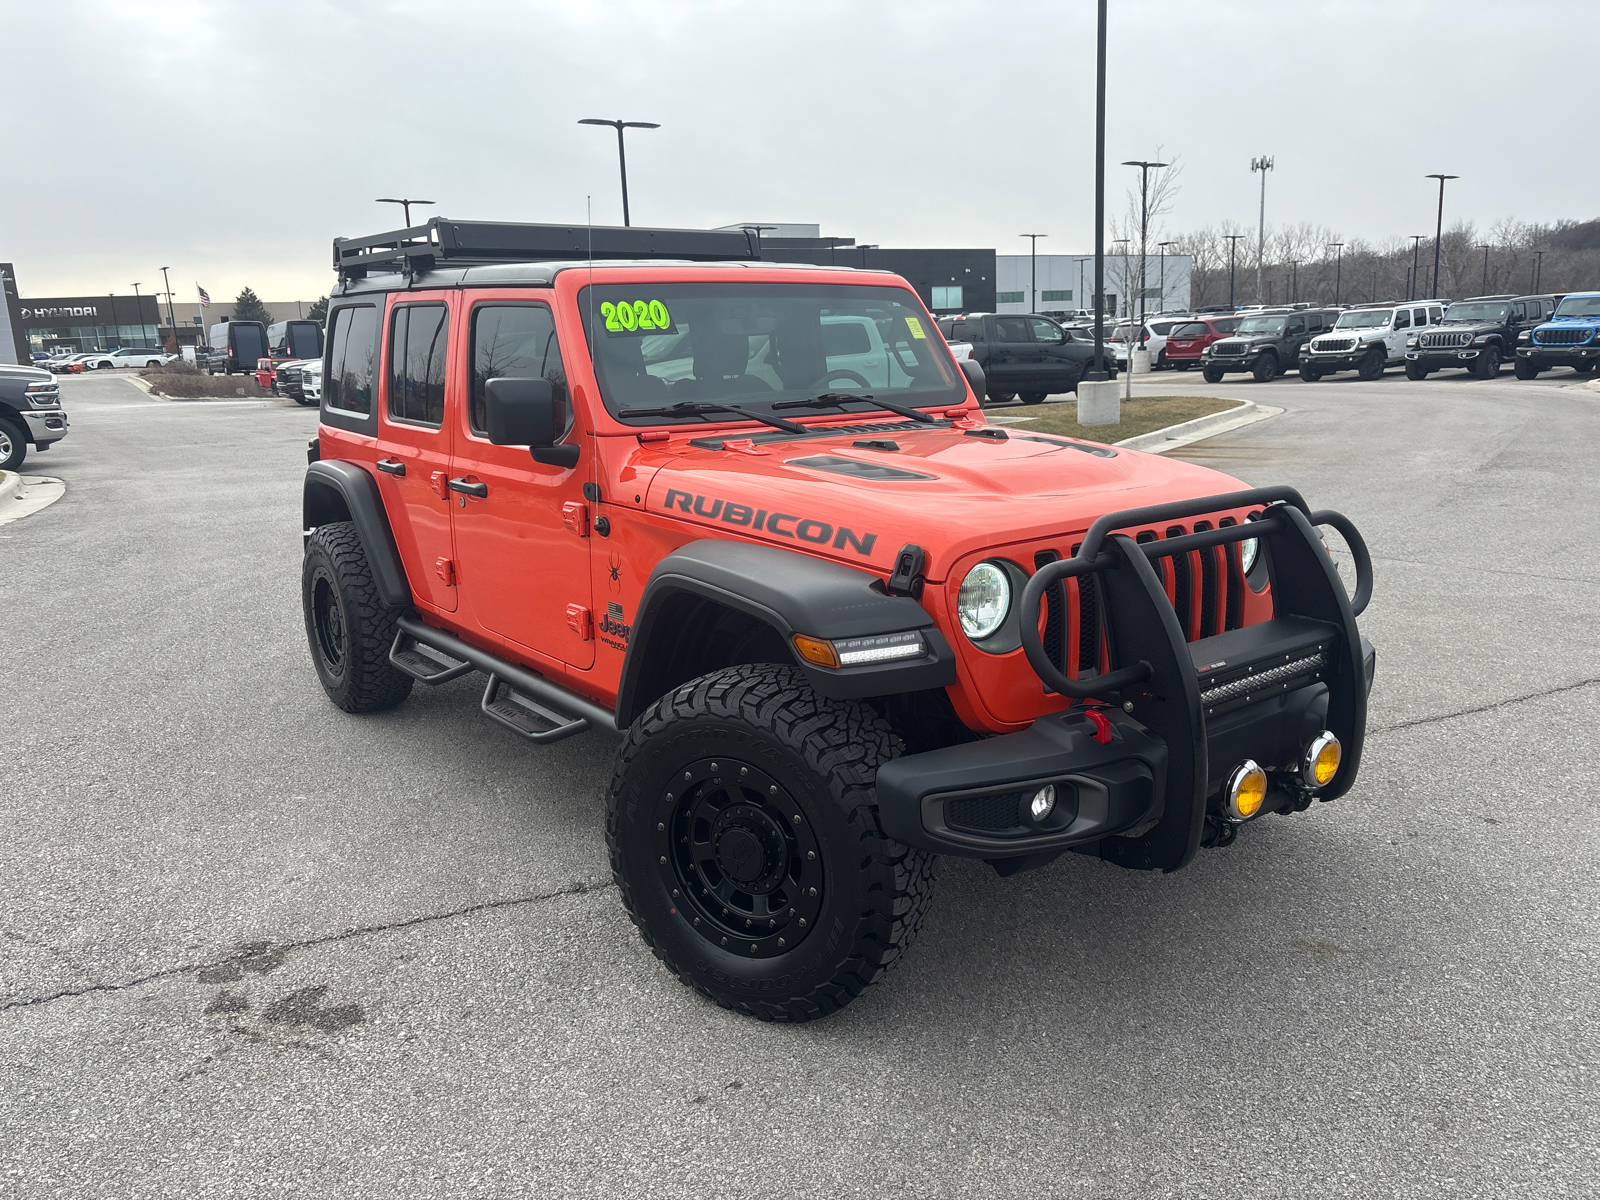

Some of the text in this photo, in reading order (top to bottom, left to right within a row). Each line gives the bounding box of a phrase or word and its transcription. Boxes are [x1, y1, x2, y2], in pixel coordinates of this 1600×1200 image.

[34, 306, 98, 318] HYUNDAI
[600, 299, 671, 332] 2020
[663, 488, 879, 557] RUBICON
[599, 613, 632, 644] Jeep
[600, 636, 628, 649] WRANGL
[695, 916, 845, 994] BFGoodrich
